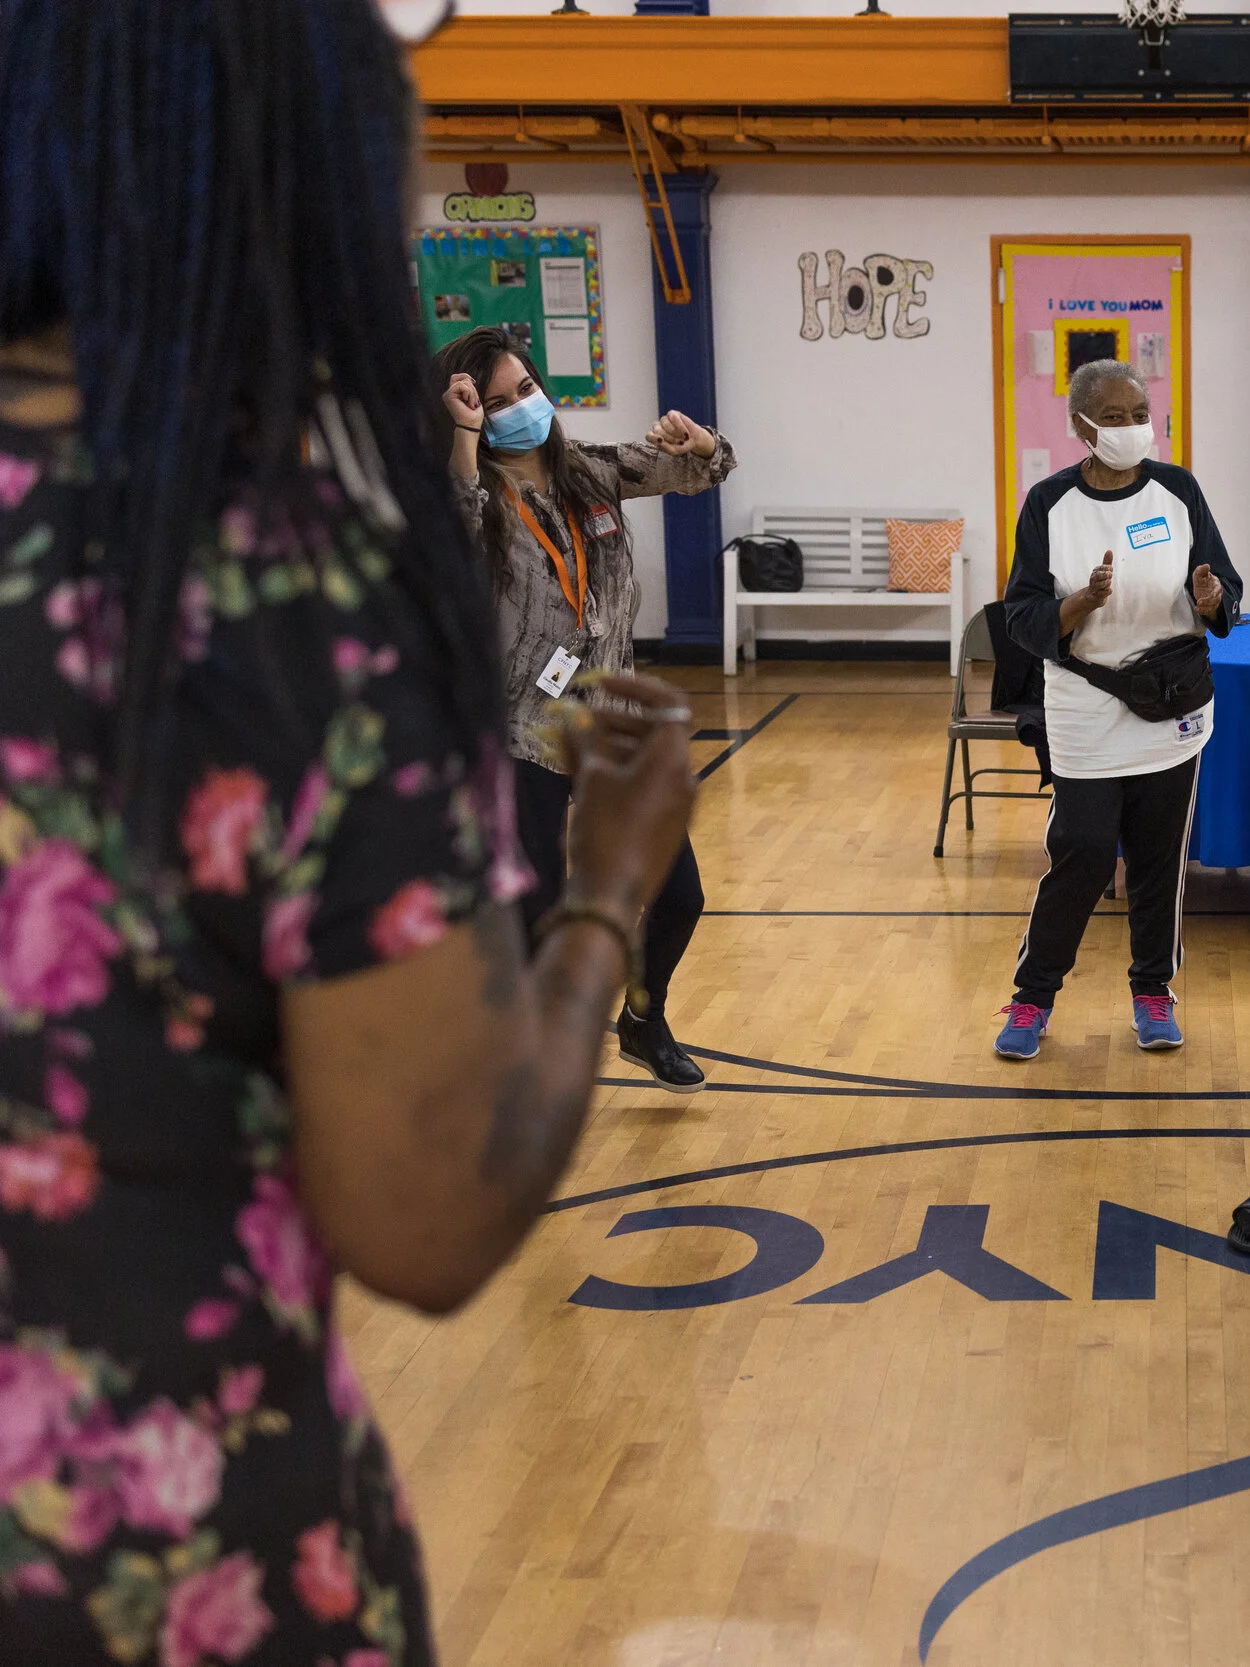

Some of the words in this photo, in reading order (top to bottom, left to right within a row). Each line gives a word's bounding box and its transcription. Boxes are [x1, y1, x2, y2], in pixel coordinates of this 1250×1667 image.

[798, 249, 934, 341] HOPE
[1059, 299, 1096, 312] LOVE
[1100, 300, 1129, 312] YOU
[1129, 299, 1164, 312] MOM
